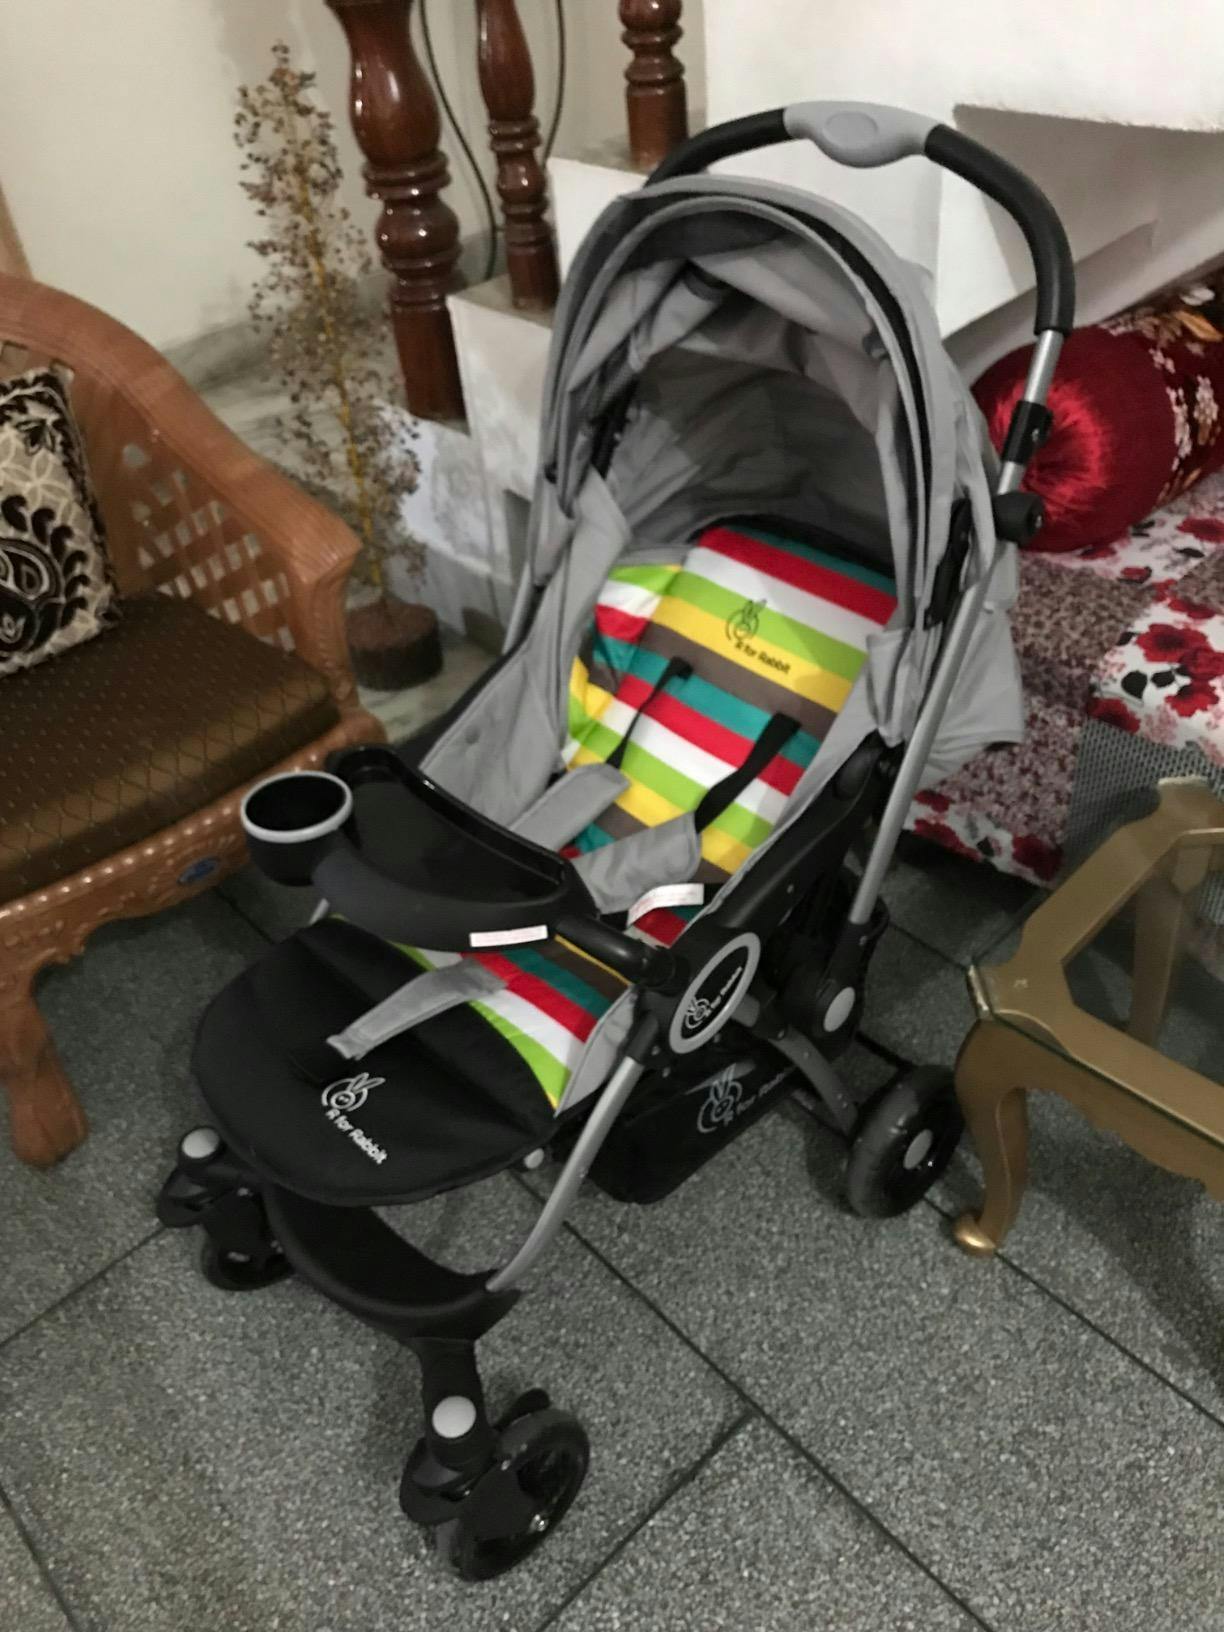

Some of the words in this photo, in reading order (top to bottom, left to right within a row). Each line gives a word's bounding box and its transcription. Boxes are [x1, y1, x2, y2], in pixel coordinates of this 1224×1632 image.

[757, 651, 790, 674] Rabbit
[325, 1108, 340, 1120] R
[334, 1115, 354, 1131] for
[348, 1129, 388, 1164] Rabbit
